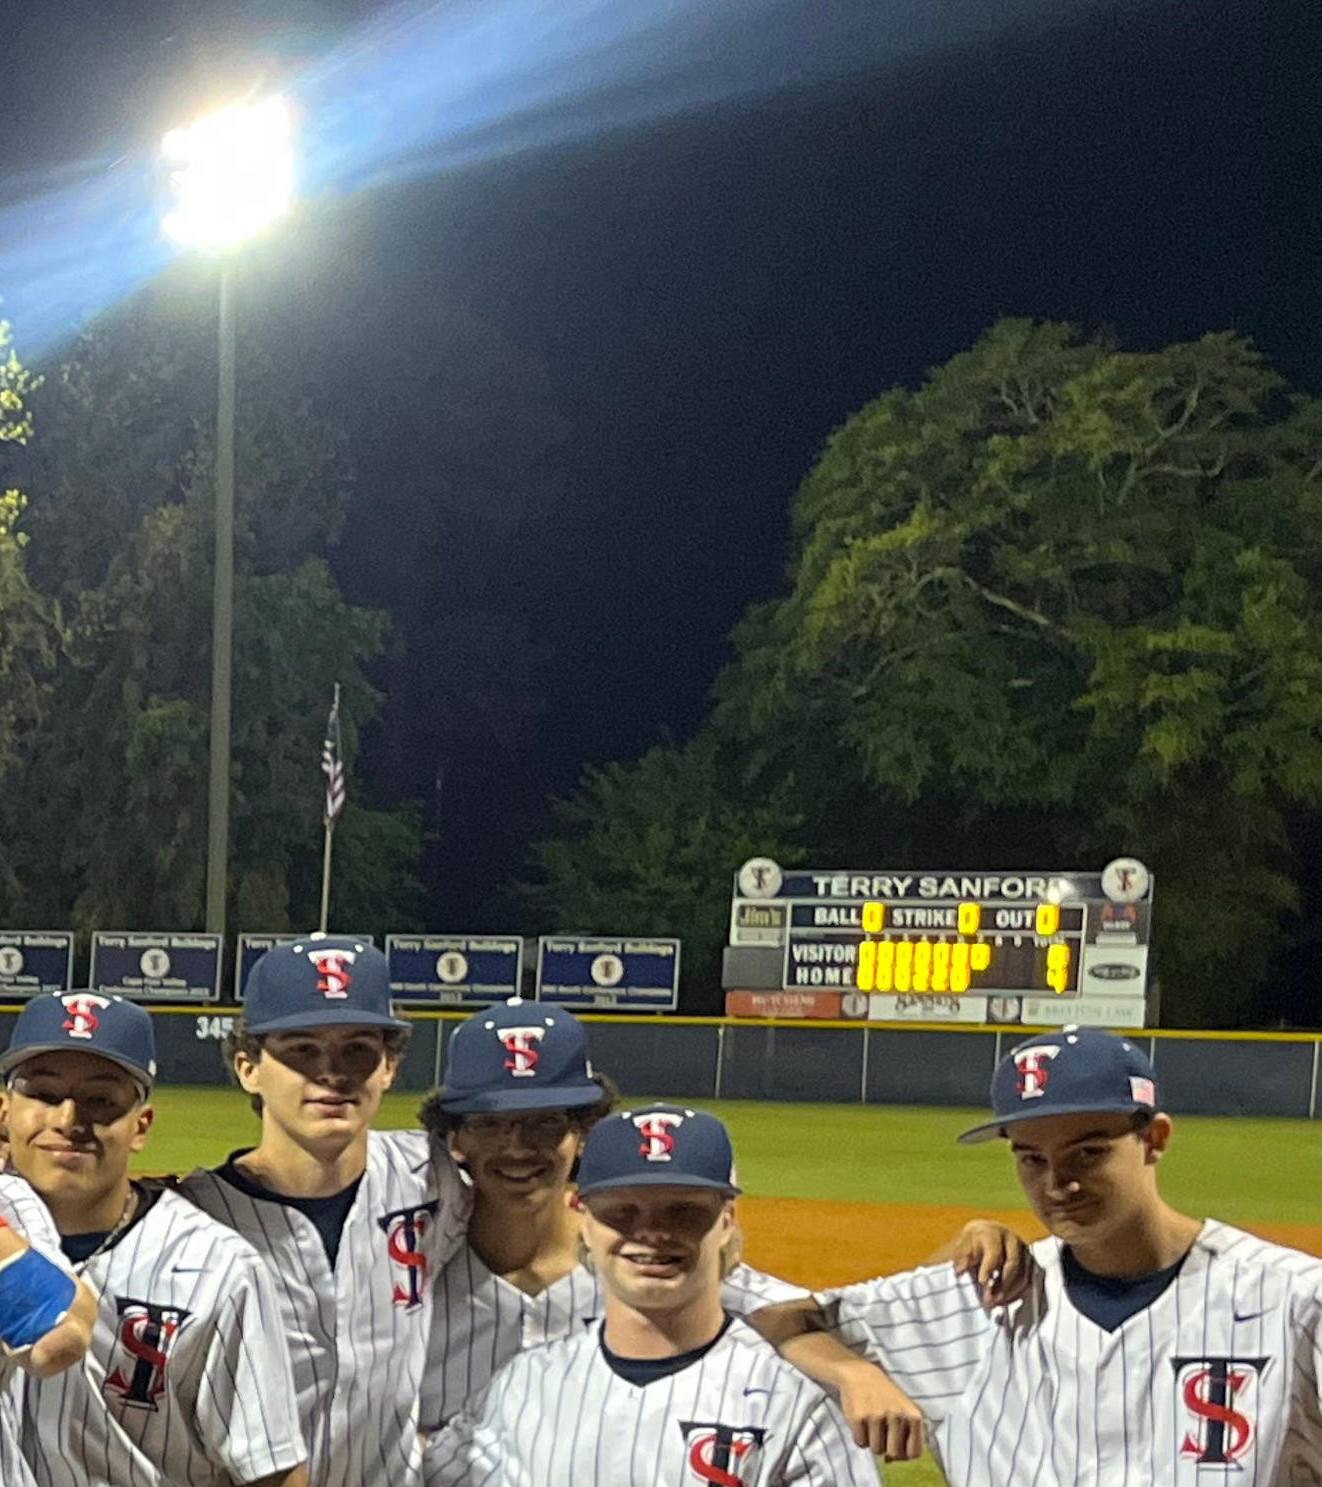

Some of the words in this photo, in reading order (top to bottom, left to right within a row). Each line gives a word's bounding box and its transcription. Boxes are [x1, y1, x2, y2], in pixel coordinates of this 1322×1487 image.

[812, 876, 913, 897] TERRY
[814, 907, 862, 926] BALL
[892, 908, 957, 927] STRIKE
[995, 909, 1034, 928] OUT
[793, 943, 857, 963] VISITOR
[796, 967, 853, 985] HOME
[196, 1016, 234, 1039] 345
